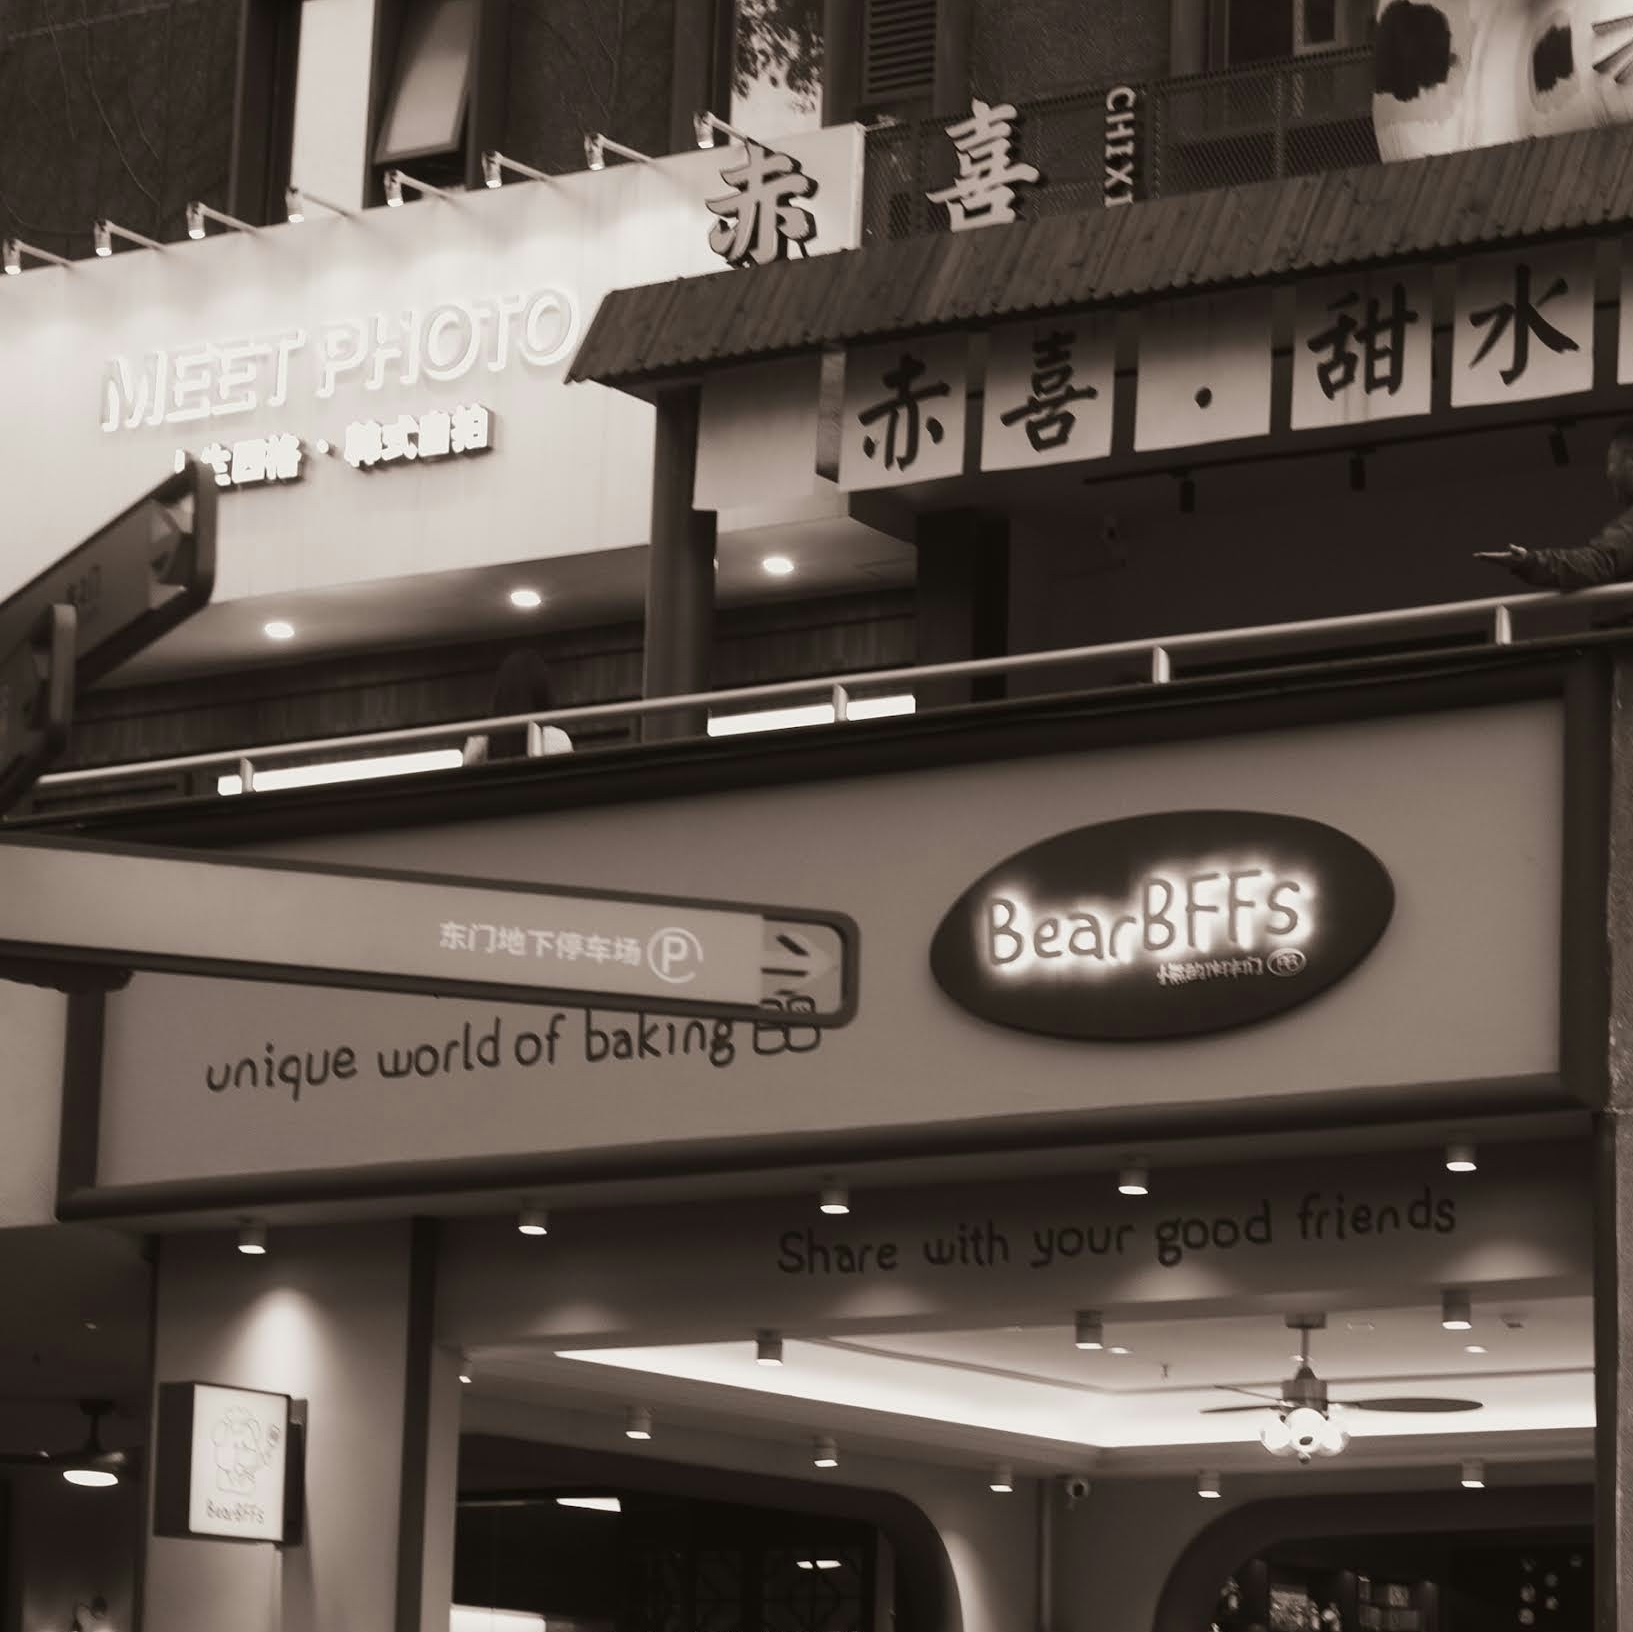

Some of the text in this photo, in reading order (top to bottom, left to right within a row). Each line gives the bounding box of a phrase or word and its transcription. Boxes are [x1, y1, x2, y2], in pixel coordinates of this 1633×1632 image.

[705, 98, 1040, 269] 赤喜
[1104, 85, 1136, 207] CHIXI
[101, 288, 582, 432] MEET PHOTO
[439, 921, 642, 967] 东门地下停车场
[205, 1042, 356, 1102] unique
[377, 1016, 501, 1078] world
[515, 1012, 566, 1066] of
[586, 1007, 736, 1068] baking
[778, 1186, 1457, 1276] Share with your good friends
